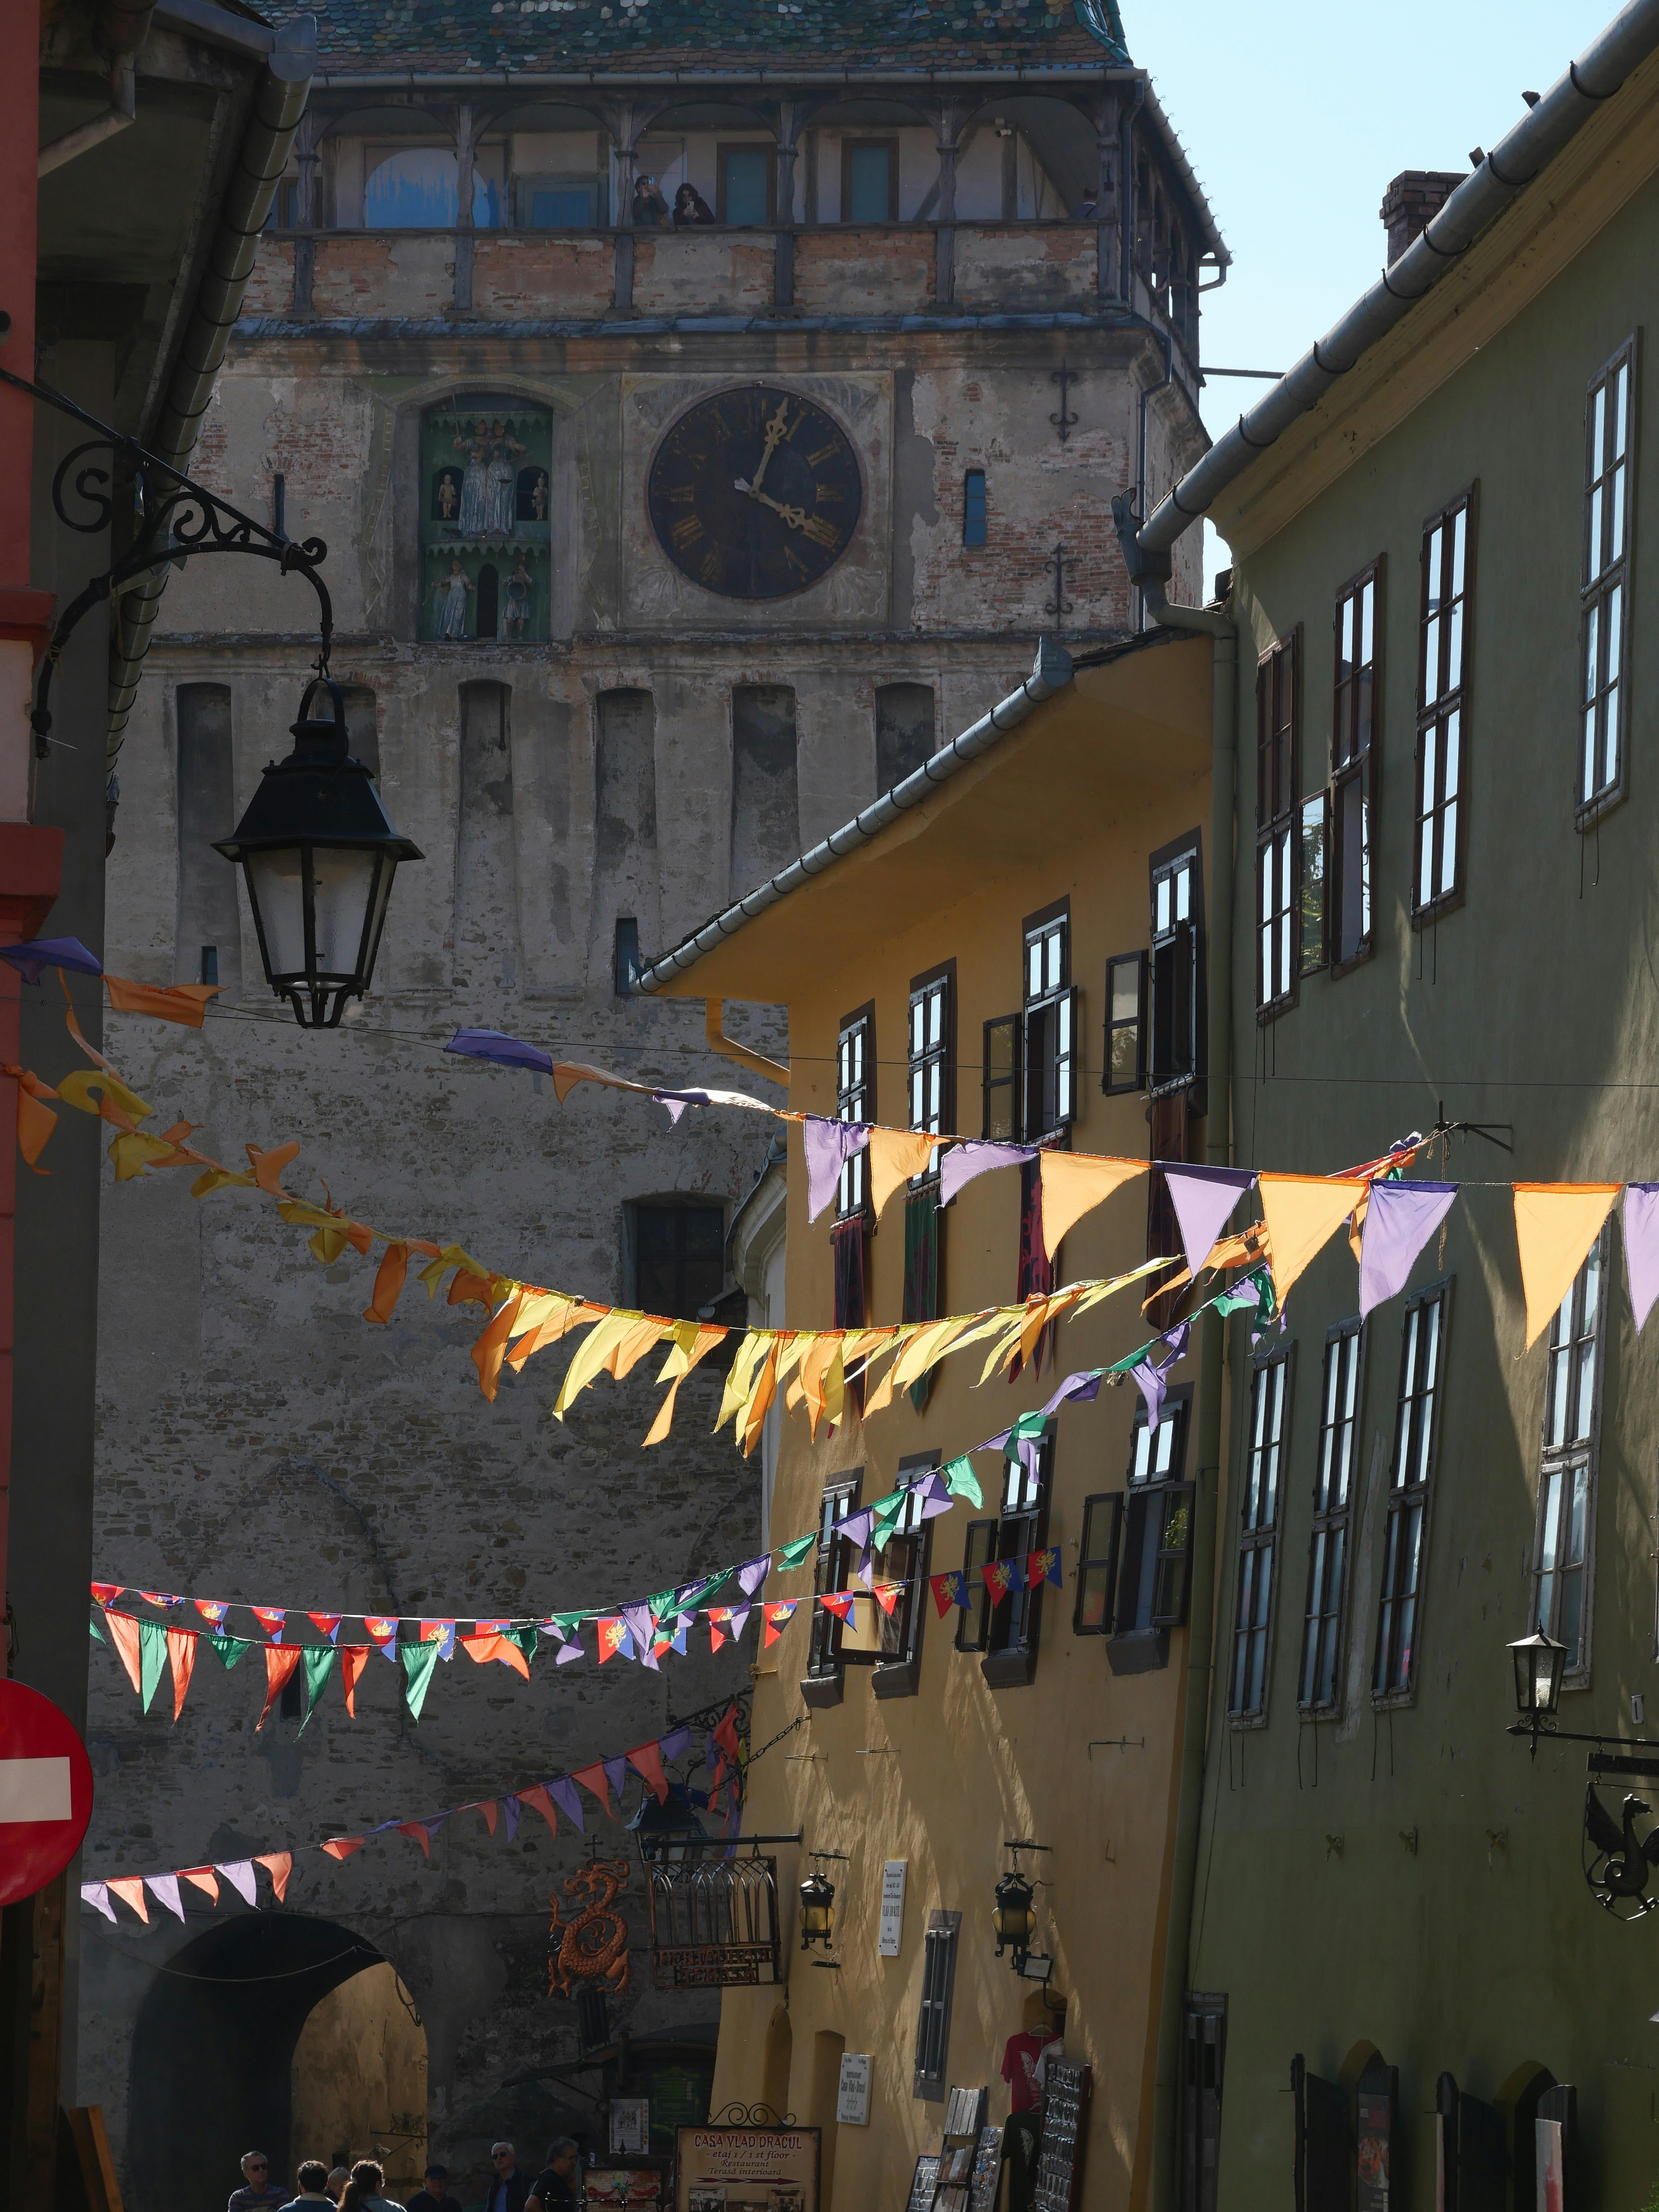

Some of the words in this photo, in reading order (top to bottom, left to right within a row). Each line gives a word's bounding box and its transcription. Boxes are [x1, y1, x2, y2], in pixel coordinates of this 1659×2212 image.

[695, 2134, 723, 2148] CASA
[727, 2135, 756, 2149] VLAD
[760, 2135, 802, 2149] DRACUL
[713, 2151, 732, 2160] etaj
[765, 2151, 790, 2160] floor
